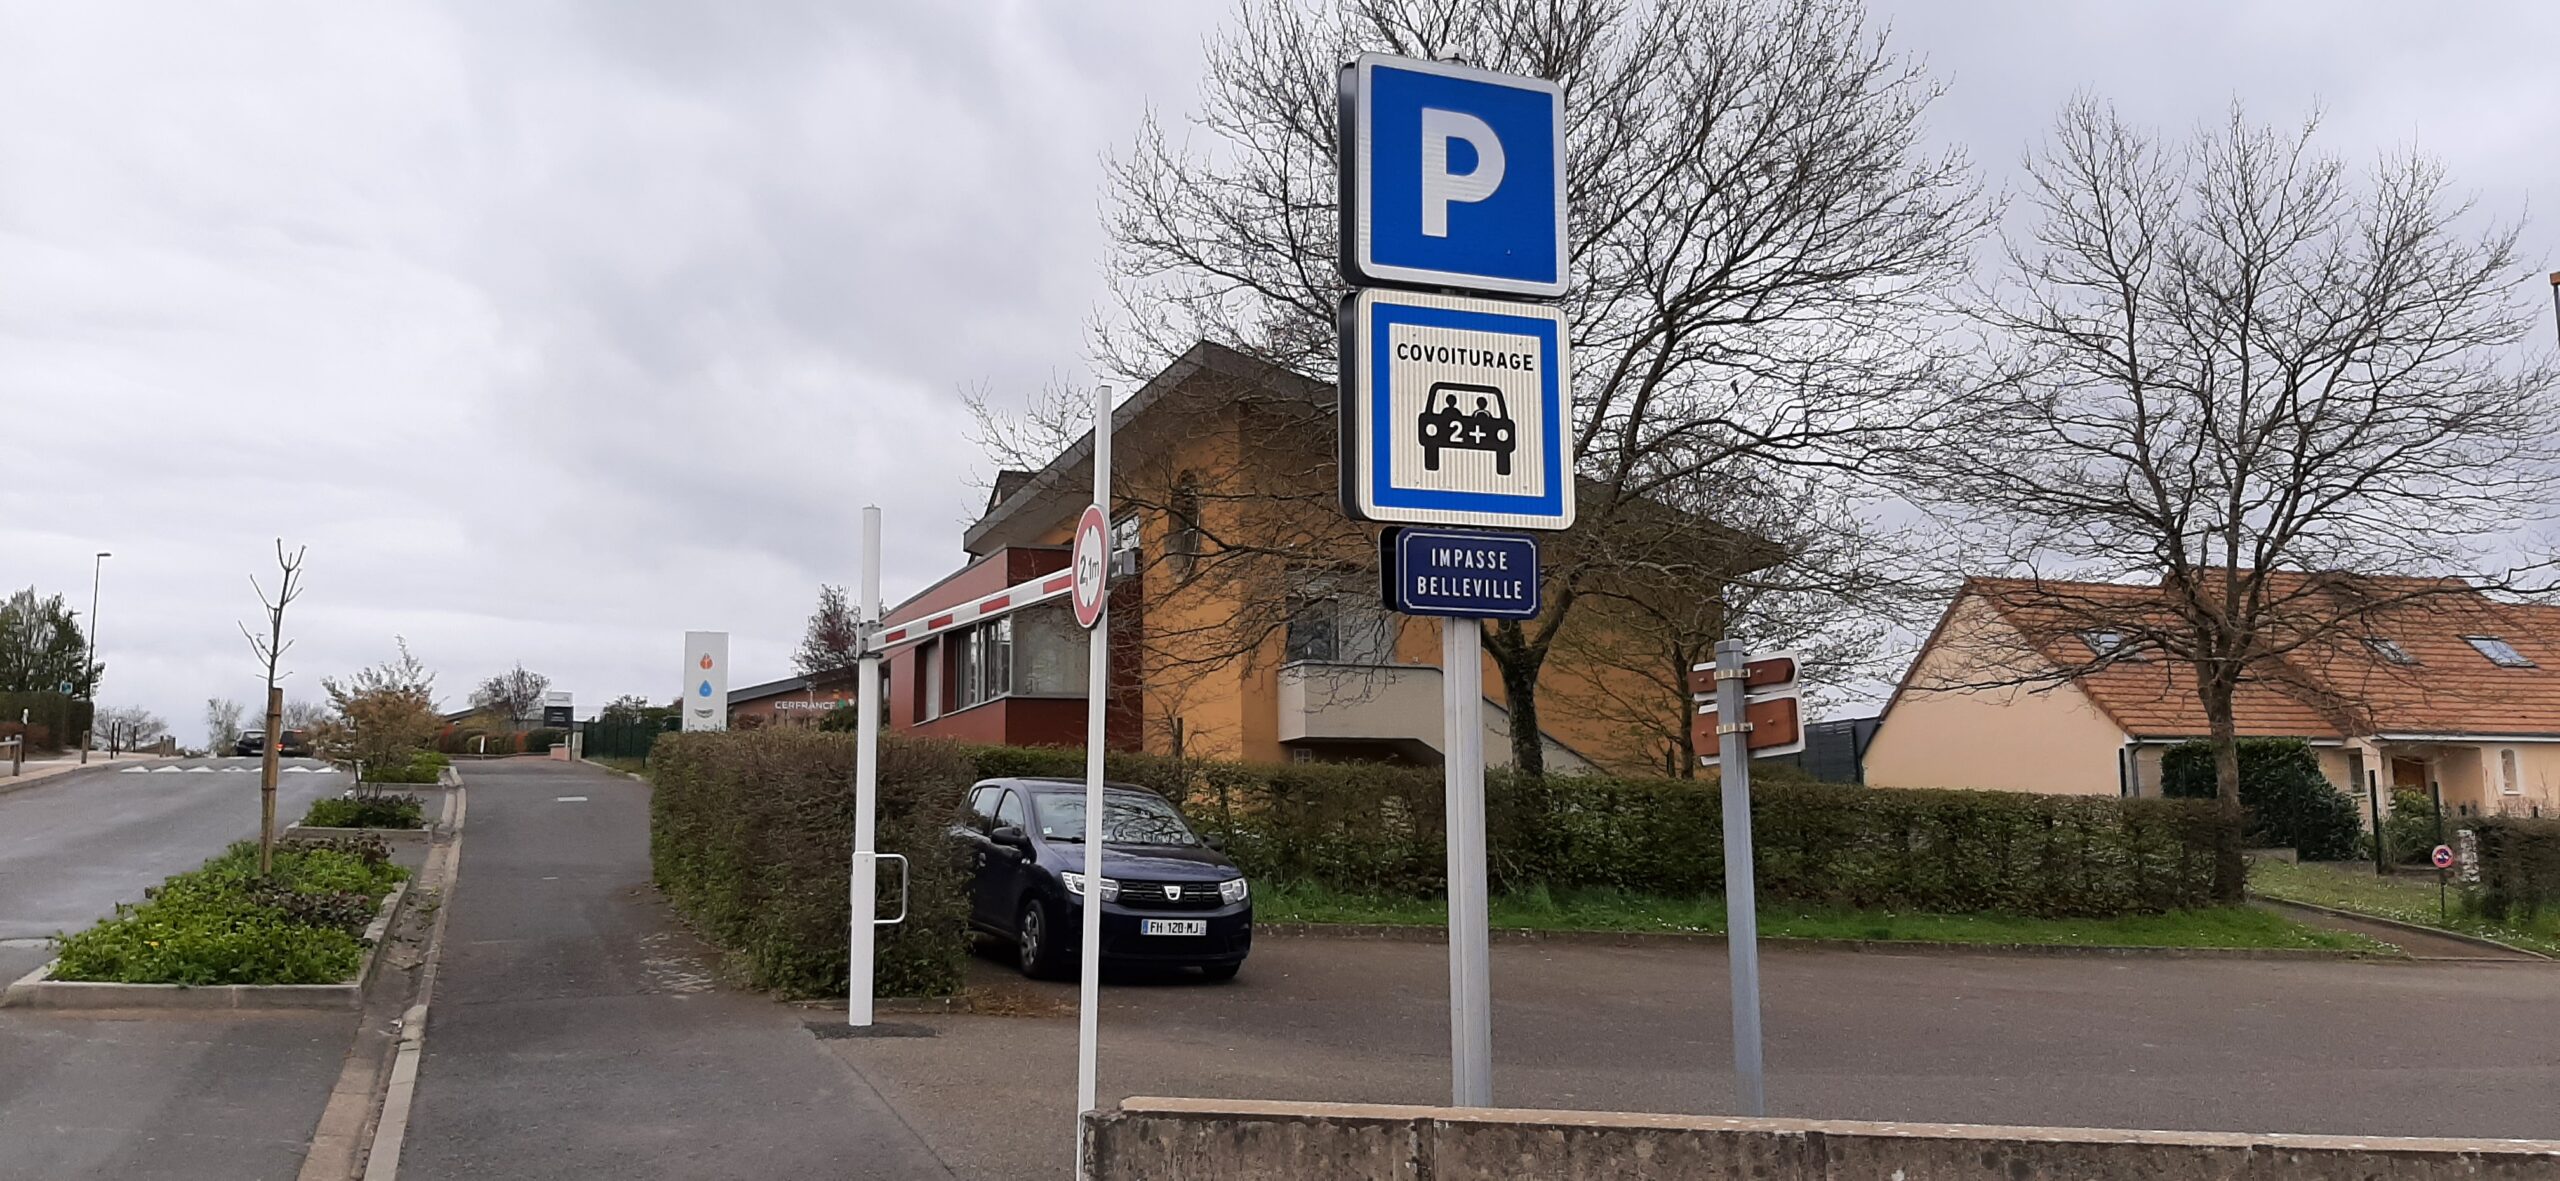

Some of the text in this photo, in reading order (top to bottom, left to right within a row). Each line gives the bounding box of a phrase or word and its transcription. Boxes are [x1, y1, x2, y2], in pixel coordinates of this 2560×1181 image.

[1421, 107, 1505, 238] P
[1396, 342, 1534, 372] COVOITURAGE
[1431, 547, 1508, 571] IMPASSE
[1416, 575, 1523, 600] BELLEVILLE
